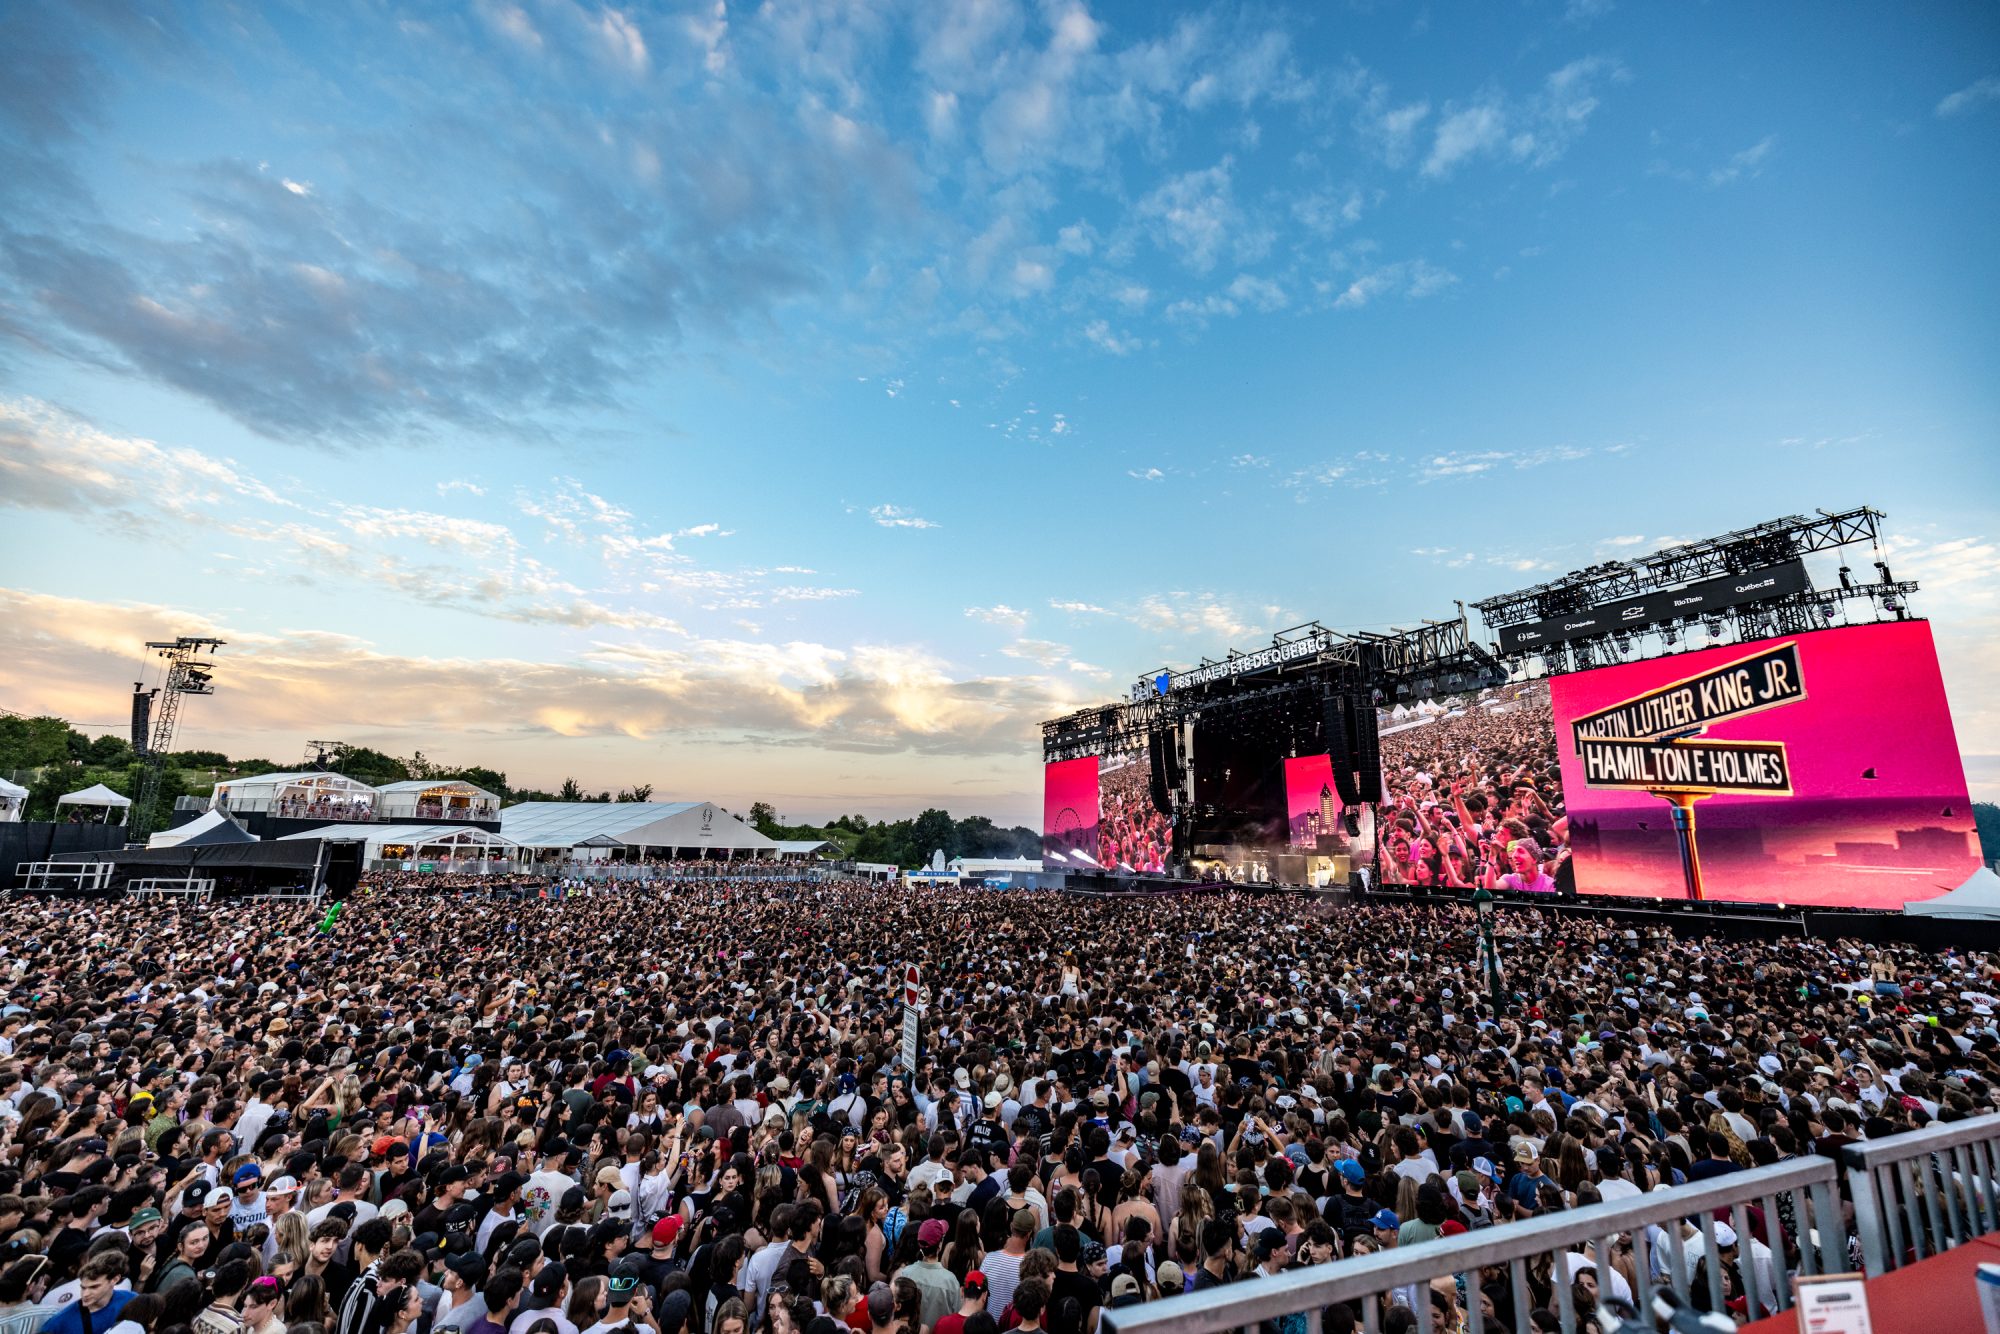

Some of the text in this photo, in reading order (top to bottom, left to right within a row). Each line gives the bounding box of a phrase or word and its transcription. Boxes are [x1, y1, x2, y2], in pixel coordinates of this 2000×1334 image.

[1735, 583, 1765, 593] Québec
[1131, 636, 1327, 702] Bell FESTIVAL D'ÉTÉ DE QUÉBEC
[1631, 689, 1697, 737] LUTHER
[1700, 669, 1754, 717] KING
[1759, 659, 1798, 700] JR.
[1587, 744, 1783, 785] HAMILTON E HOLMES
